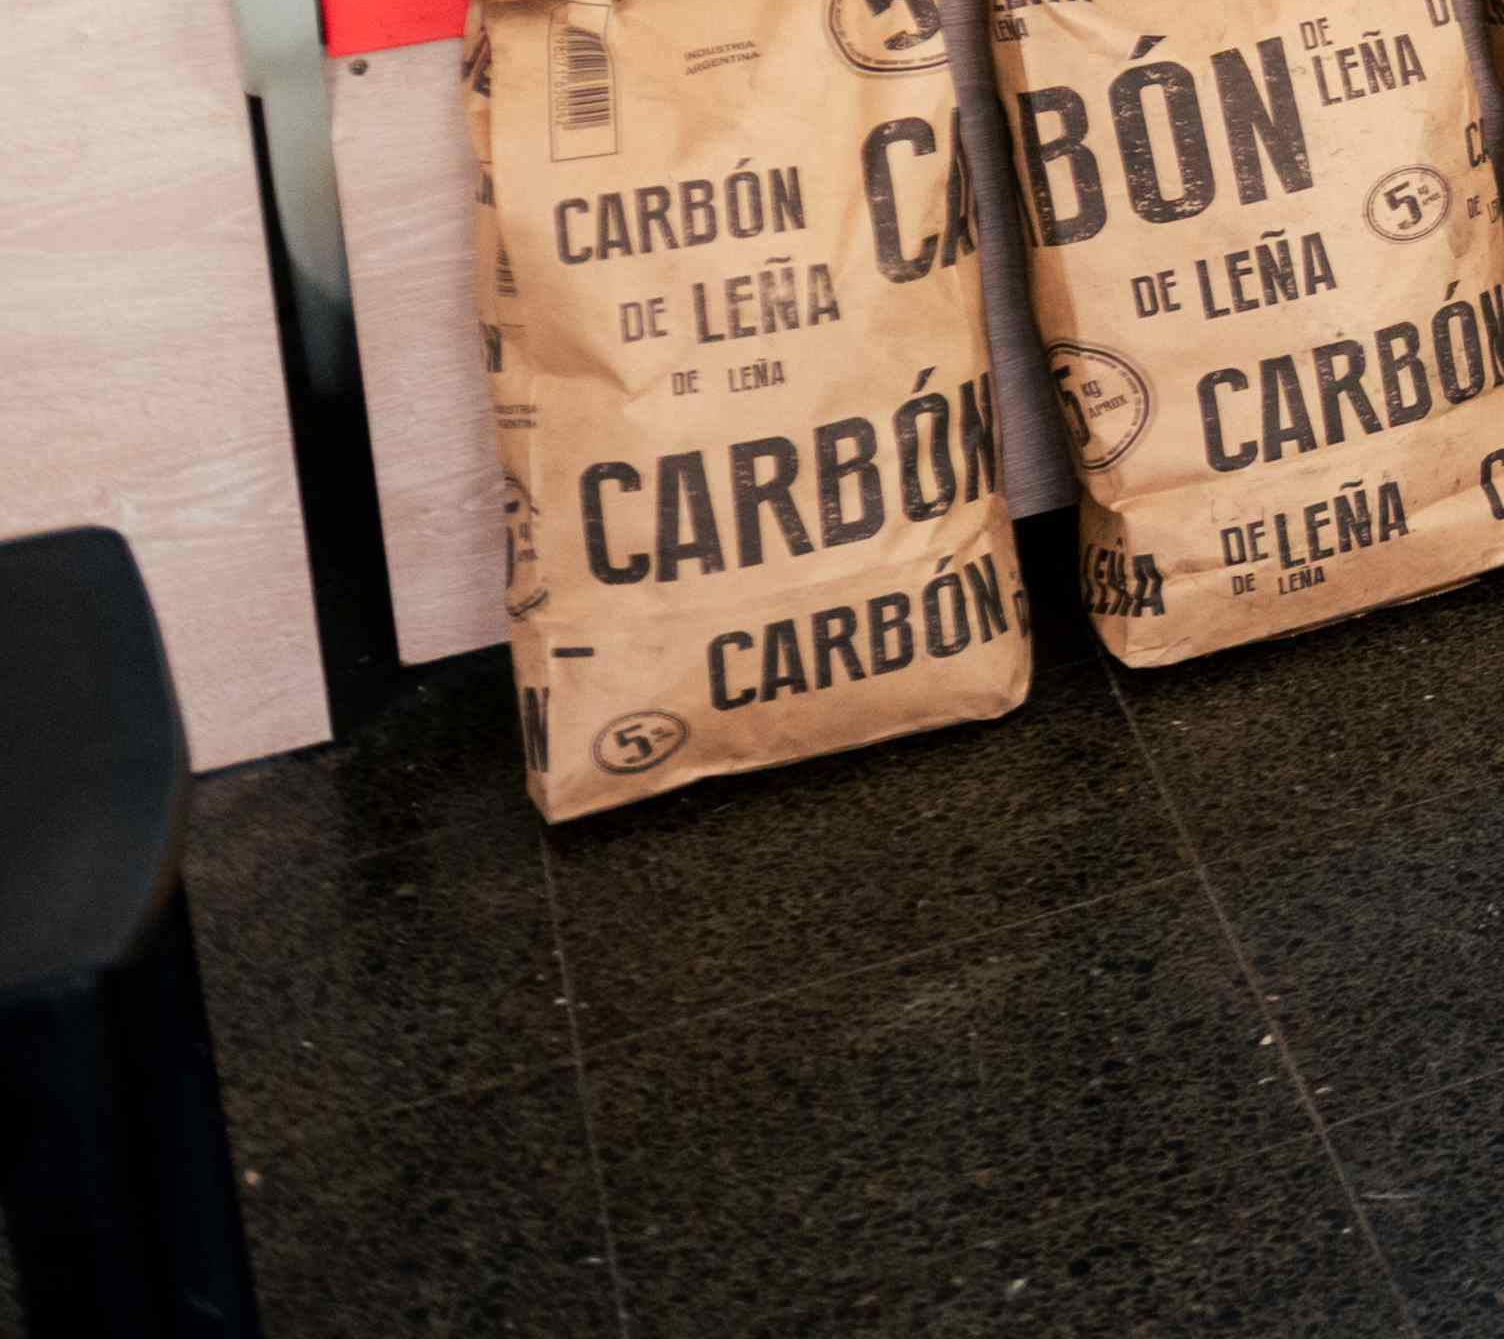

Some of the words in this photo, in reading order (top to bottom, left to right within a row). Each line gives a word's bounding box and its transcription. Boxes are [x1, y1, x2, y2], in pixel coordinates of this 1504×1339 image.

[684, 40, 759, 61] INDUSTRIA
[685, 50, 762, 76] ARGENTINA
[1300, 17, 1335, 52] DE
[1312, 30, 1427, 108] LEÑA
[554, 156, 807, 267] CARBÓN
[1382, 181, 1422, 232] 5
[619, 296, 668, 344] DE
[692, 256, 843, 344] LEÑA
[1130, 268, 1182, 319] DE
[1194, 228, 1339, 320] LEÑA
[671, 369, 701, 398] DE
[727, 359, 787, 395] LEÑA
[579, 365, 997, 587] CARBÓN
[1220, 521, 1270, 569] DE
[1273, 479, 1411, 572] LEÑA
[1231, 572, 1256, 597] DE
[1277, 564, 1327, 597] LEÑA
[707, 554, 1009, 712] CARBÓN
